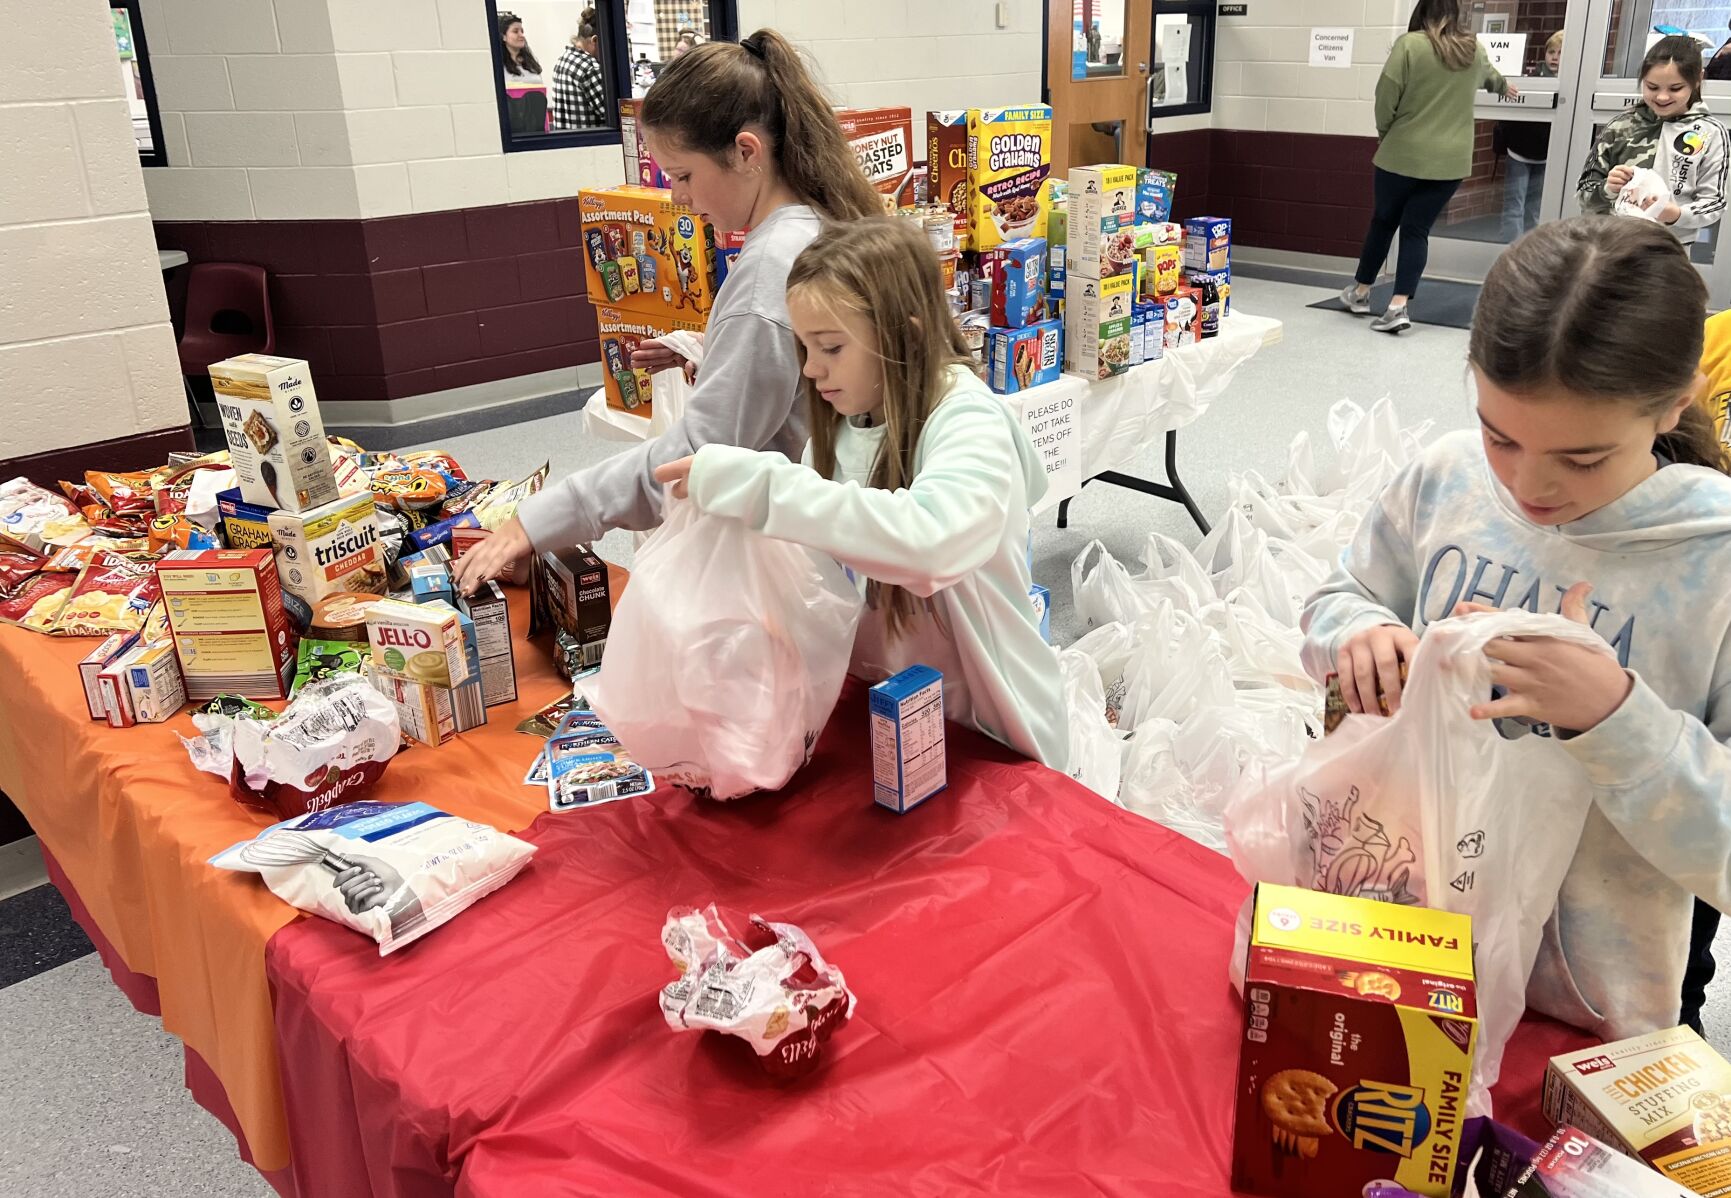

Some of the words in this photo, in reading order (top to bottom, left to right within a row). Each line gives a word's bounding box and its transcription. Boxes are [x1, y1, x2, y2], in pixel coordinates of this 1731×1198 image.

[1498, 95, 1526, 104] PUSH
[1005, 110, 1028, 120] FAMILY
[1030, 109, 1044, 120] SIZE
[854, 139, 880, 153] ONEY
[881, 133, 899, 147] NUT
[856, 143, 903, 166] OASTED
[931, 137, 939, 183] Cheerios
[1670, 155, 1684, 183] Sport
[1674, 157, 1693, 195] Justice
[987, 180, 1014, 195] RETRO
[1016, 169, 1041, 188] RECIPE
[1144, 179, 1166, 188] TREATS
[581, 210, 632, 224] Assortment
[633, 211, 655, 226] Pack
[679, 218, 692, 231] 30
[1157, 259, 1176, 275] POPS
[600, 322, 646, 335] Assortment
[278, 378, 302, 391] Made
[219, 402, 242, 421] WOVEN
[1028, 403, 1059, 420] PLEASE
[1061, 398, 1073, 409] DO
[1031, 421, 1048, 434] NOT
[1050, 414, 1071, 427] TAKE
[226, 430, 249, 449] SEEDS
[1033, 435, 1054, 448] TEMS
[1056, 427, 1072, 440] OFF
[1044, 446, 1060, 460] THE
[1046, 458, 1067, 474] BLE!!!
[230, 523, 269, 541] GRAHAM
[232, 535, 258, 549] CRAC
[276, 529, 296, 538] Made
[314, 522, 377, 566] triscuit
[102, 555, 156, 573] IDAHOA
[334, 552, 366, 573] CHEDDAR
[579, 586, 605, 595] Chocolate
[579, 591, 606, 602] CHUNK
[900, 693, 919, 707] Nutrition
[919, 687, 931, 696] Facts
[1309, 916, 1363, 936] SIZE
[1369, 926, 1459, 950] FAMILY
[1422, 979, 1455, 990] original
[1427, 991, 1464, 1014] RITZ
[1330, 1012, 1345, 1066] original
[1350, 1033, 1362, 1051] the
[1577, 1056, 1612, 1071] weis
[1614, 1051, 1702, 1099] CHICKEN
[1434, 1070, 1462, 1141] FAMILY
[1628, 1077, 1701, 1116] STUFFING
[1353, 1078, 1425, 1160] RITZ
[1640, 1106, 1674, 1126] MIX
[1564, 1136, 1589, 1156] 10
[1428, 1143, 1452, 1185] SIZE
[1548, 1150, 1565, 1169] POUCHES
[1518, 1164, 1538, 1185] POUCHES
